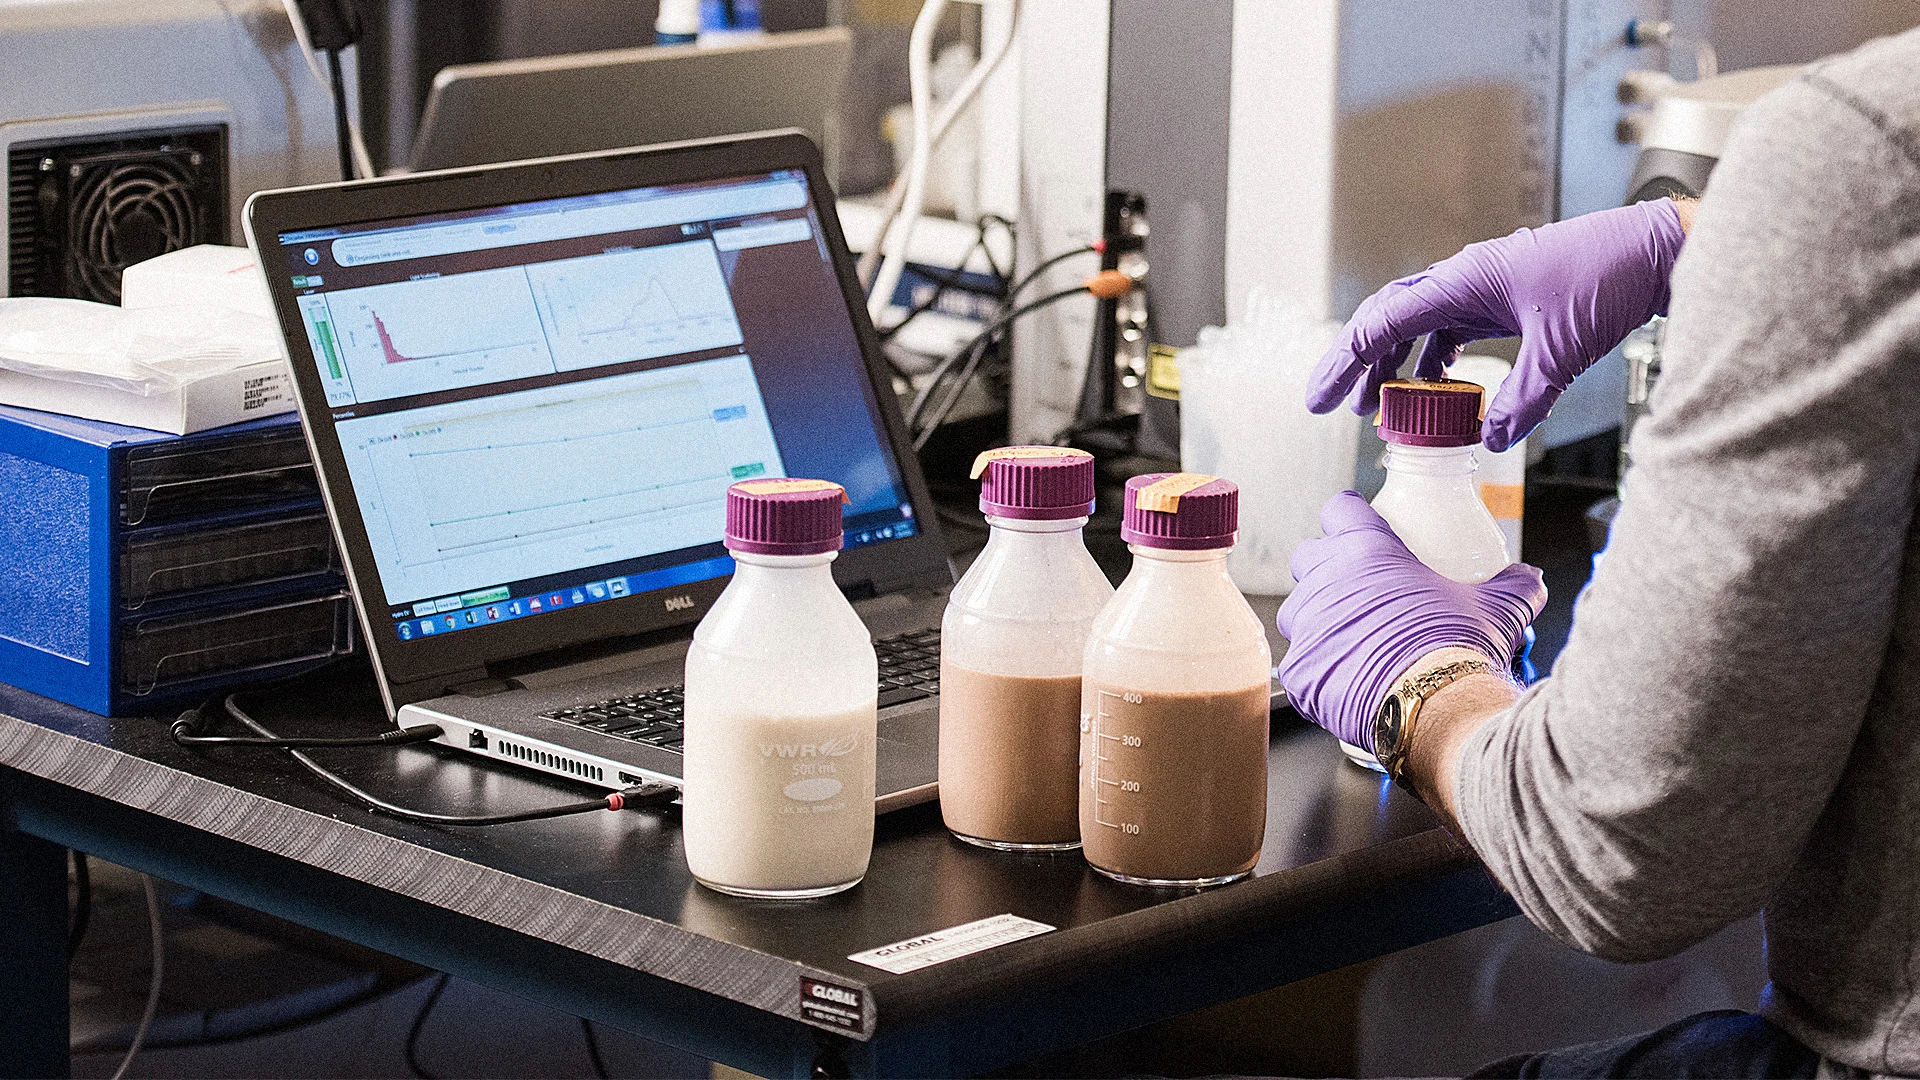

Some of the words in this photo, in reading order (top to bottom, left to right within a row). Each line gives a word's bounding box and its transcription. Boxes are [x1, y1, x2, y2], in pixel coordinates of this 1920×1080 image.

[665, 596, 695, 611] DELL
[1122, 691, 1143, 704] 400
[1121, 735, 1141, 748] 300
[760, 743, 817, 758] VWR
[1120, 779, 1140, 792] 200
[1120, 822, 1140, 835] 100
[875, 936, 944, 957] GLOBAL
[812, 984, 859, 1007] GLOBAL
